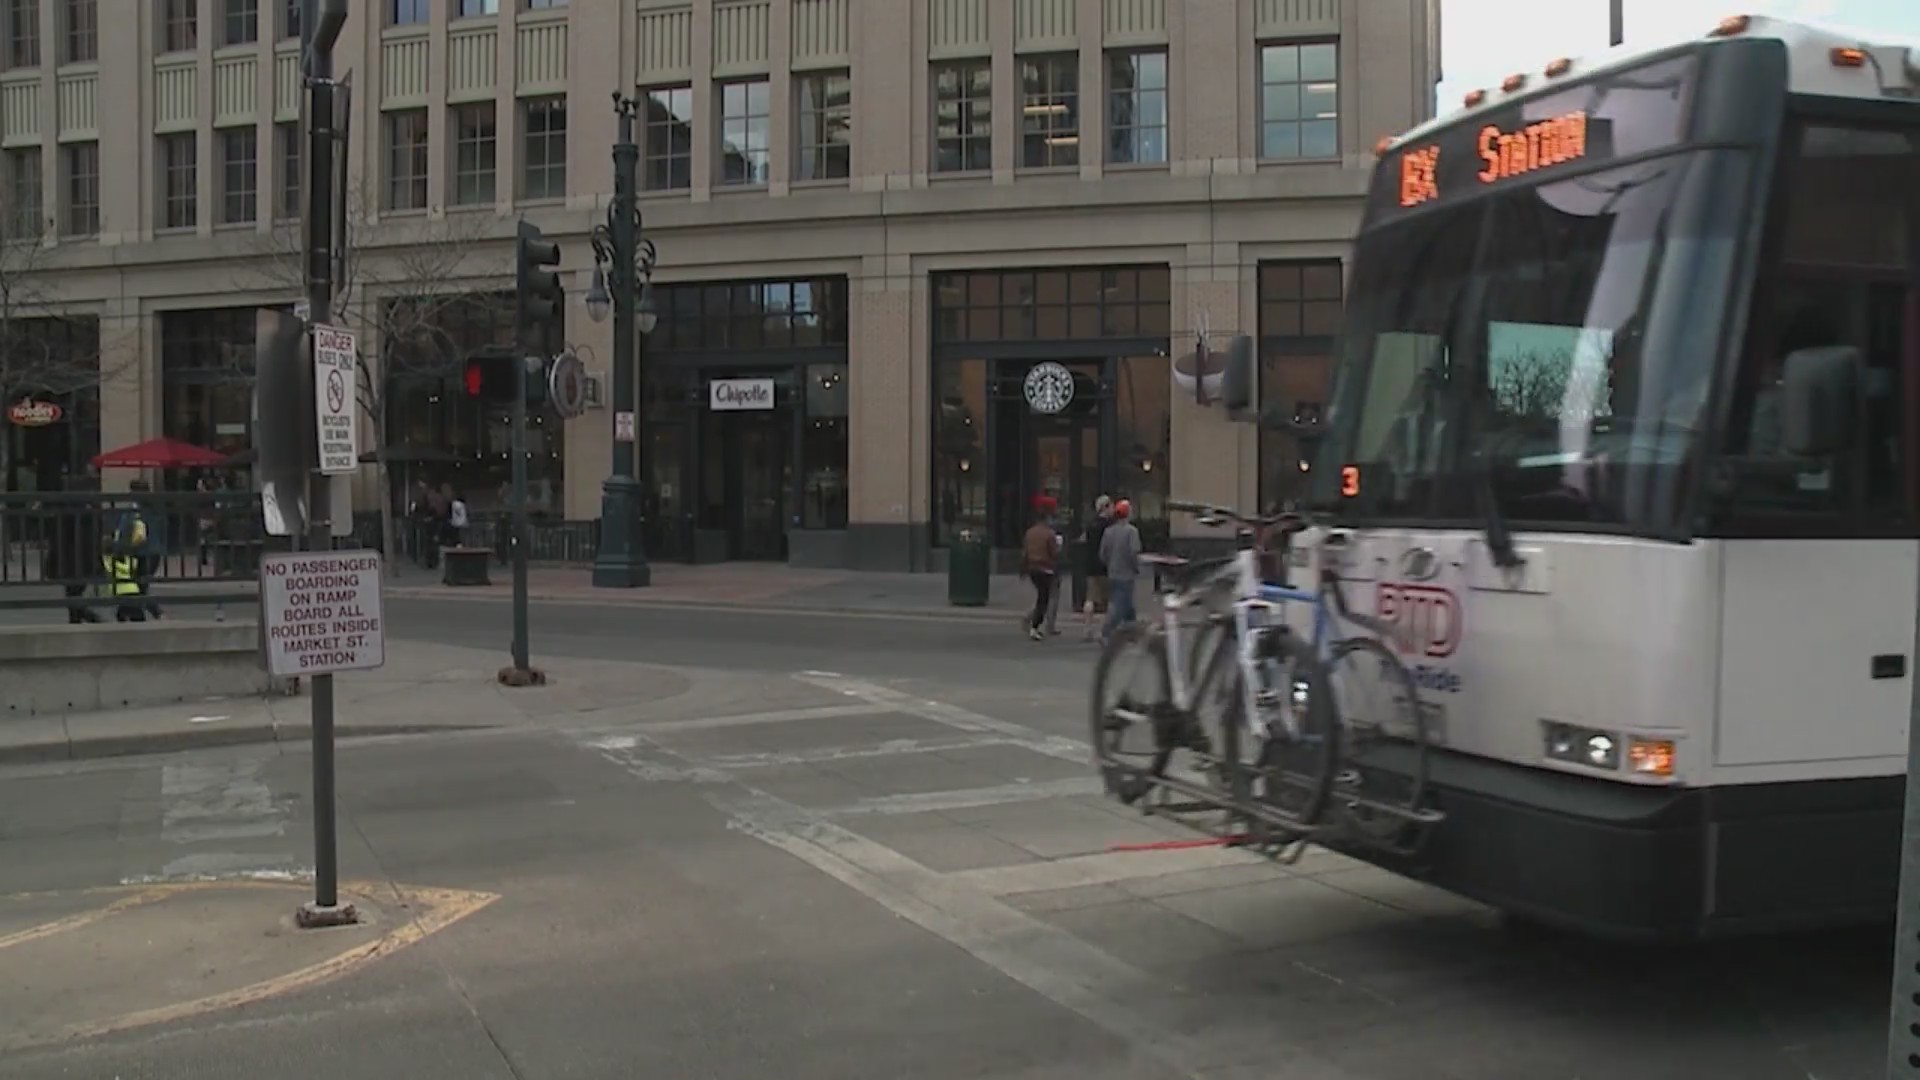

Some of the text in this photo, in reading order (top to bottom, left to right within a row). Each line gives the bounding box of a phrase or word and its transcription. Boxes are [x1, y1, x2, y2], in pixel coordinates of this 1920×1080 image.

[319, 331, 352, 351] DANGER
[716, 383, 769, 406] Chipotle
[1341, 466, 1360, 496] 3
[265, 558, 377, 576] NO PASSENGER
[286, 574, 359, 590] BOARDING
[290, 590, 357, 606] ON RAMP
[284, 605, 364, 621] BOARD ALL
[271, 618, 379, 638] ROUTES INSIDE
[284, 635, 369, 653] MARKET ST.
[299, 652, 355, 667] STATION
